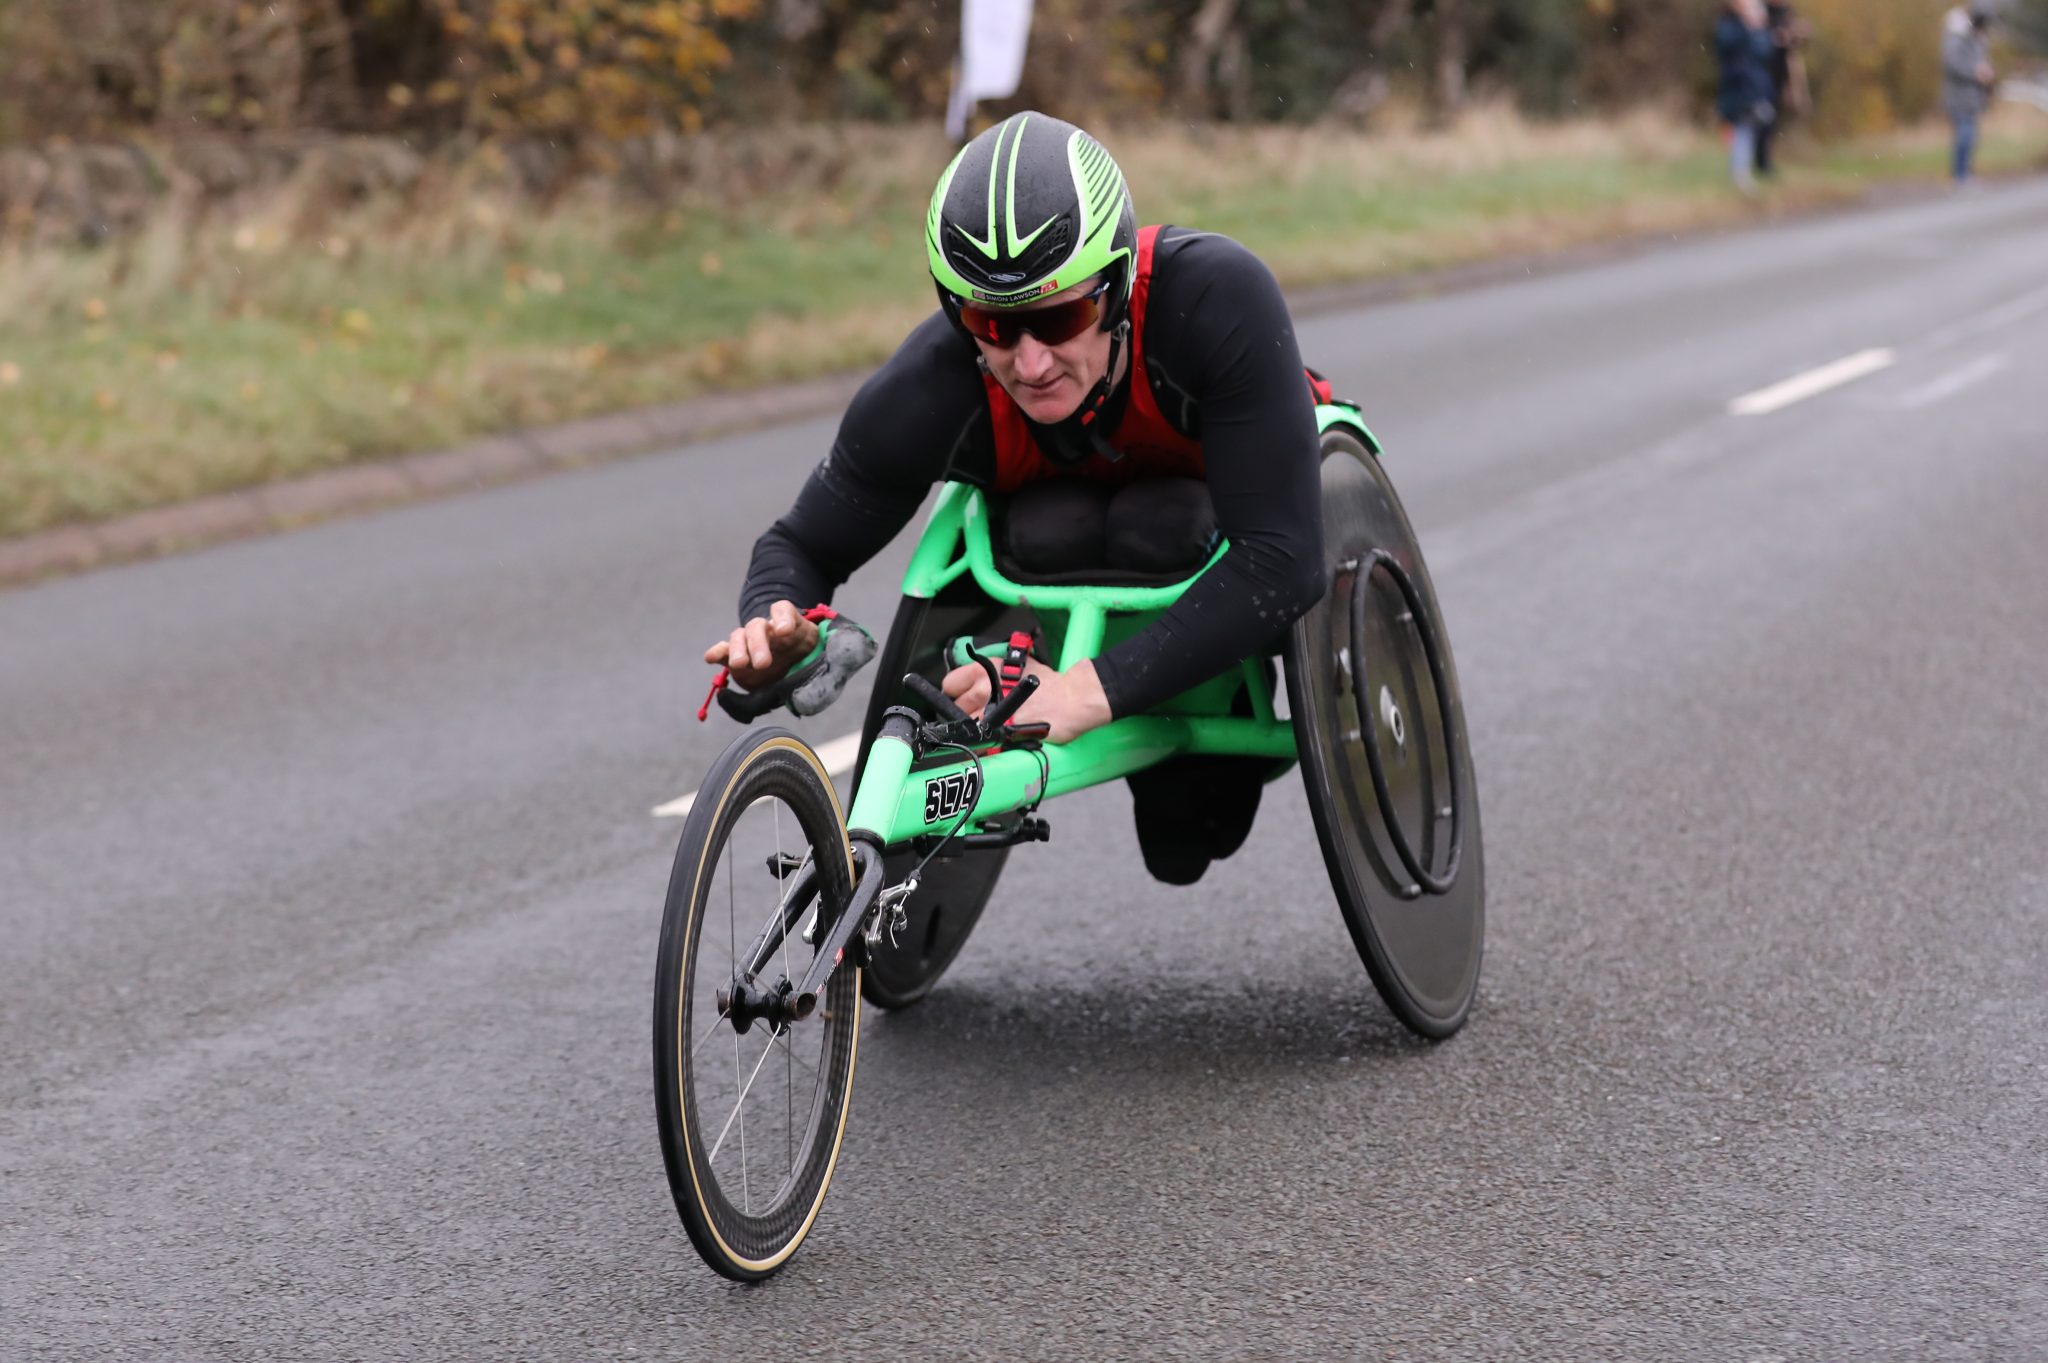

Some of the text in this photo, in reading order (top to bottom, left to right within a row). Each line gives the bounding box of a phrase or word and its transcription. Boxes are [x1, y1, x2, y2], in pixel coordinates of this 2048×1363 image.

[985, 288, 1041, 302] SIMON LAWSON
[924, 766, 980, 825] SL74
